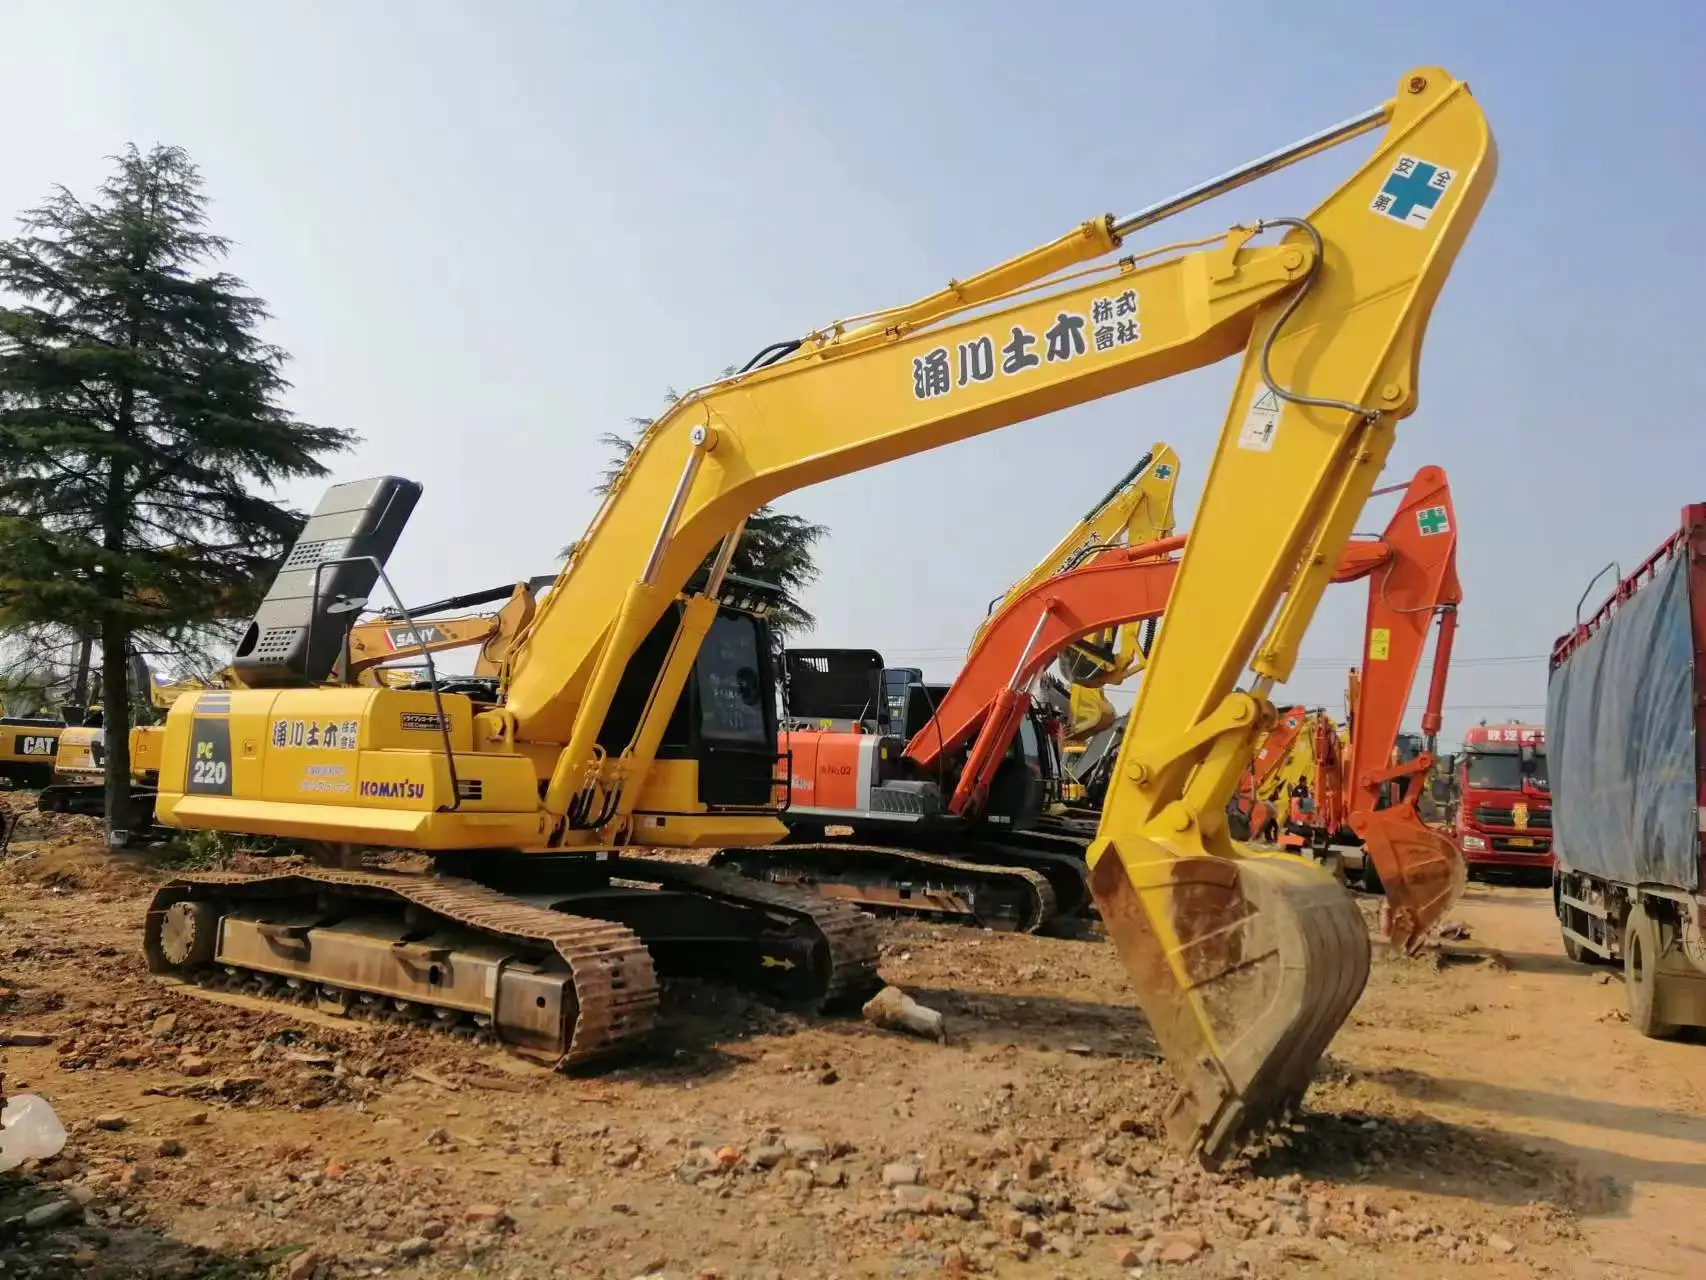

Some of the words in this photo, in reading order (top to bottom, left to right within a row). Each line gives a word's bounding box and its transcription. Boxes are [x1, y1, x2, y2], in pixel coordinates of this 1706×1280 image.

[396, 628, 434, 648] SANY
[23, 736, 54, 755] CAT
[196, 741, 213, 759] PC
[193, 760, 226, 784] 220
[360, 779, 424, 799] KOMATSU
